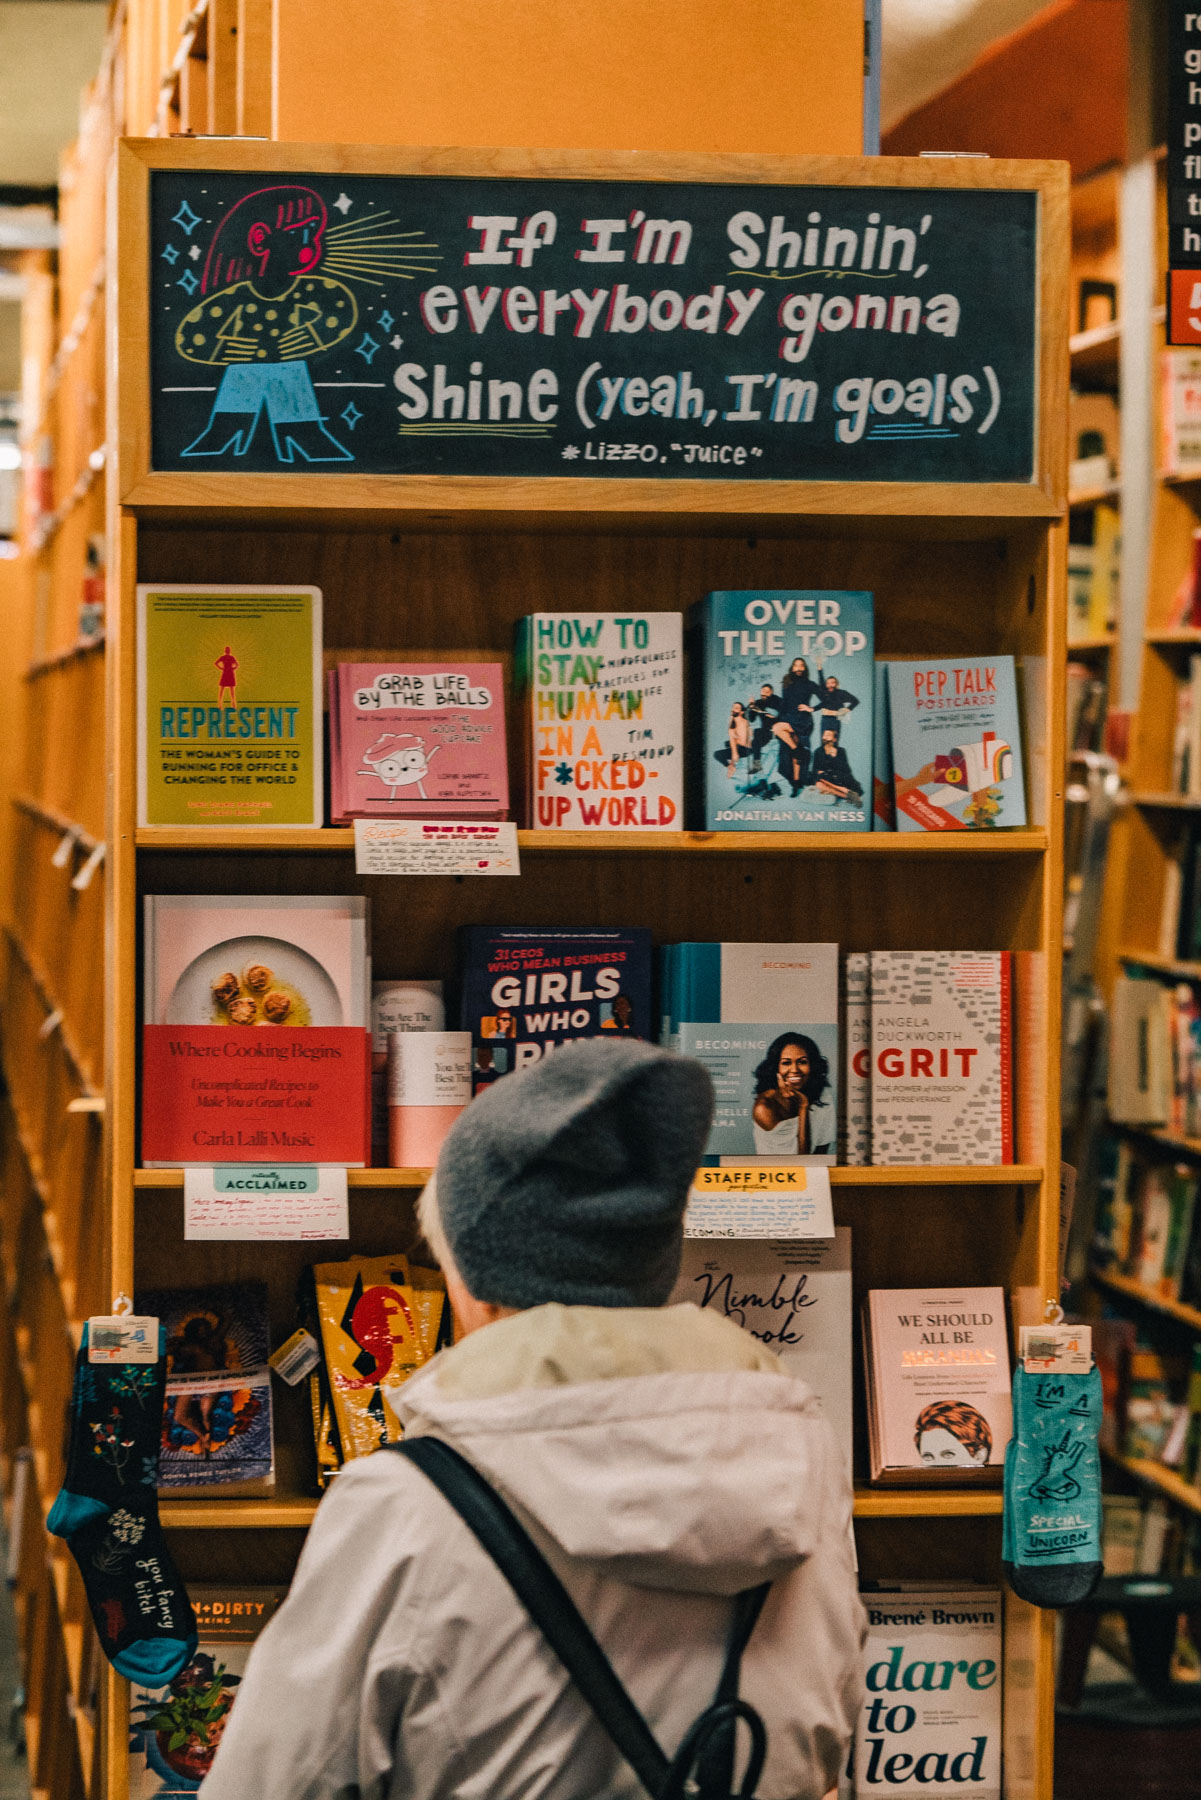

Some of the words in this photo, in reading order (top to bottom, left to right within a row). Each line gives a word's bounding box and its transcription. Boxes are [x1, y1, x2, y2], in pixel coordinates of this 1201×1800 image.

[464, 211, 557, 267] If
[575, 209, 692, 265] I'm
[420, 284, 764, 338] everybody
[779, 288, 960, 362] gonna
[393, 362, 558, 423] Shine
[576, 362, 717, 429] (yeah,
[722, 371, 819, 422] I'm
[834, 366, 1000, 443] goals)
[745, 600, 841, 625] OVER
[538, 619, 603, 649] HOW
[614, 619, 649, 649] TO
[718, 630, 786, 656] THE
[796, 630, 868, 657] TOP
[608, 650, 676, 668] MINDFULNESS
[538, 654, 603, 686] STAY
[378, 676, 424, 690] GRAB
[434, 676, 467, 690] LIFE
[589, 671, 646, 690] PRACTICES
[914, 671, 948, 697] PEP
[953, 668, 997, 695] TALK
[357, 692, 380, 708] BY
[391, 691, 425, 706] THE
[436, 690, 489, 706] BALLS
[538, 691, 643, 720] HUMAN
[916, 695, 996, 709] POSTCARDS
[160, 707, 299, 738] REPRESENT
[538, 726, 573, 756] IN
[581, 726, 603, 756] A
[627, 729, 653, 743] TIM
[160, 750, 182, 759] THE
[186, 750, 242, 759] WOMAN'S
[246, 750, 281, 759] GUIDE
[286, 750, 300, 759] TO
[612, 745, 674, 764] DESMOND
[162, 763, 217, 772] RUNNING
[220, 763, 243, 772] FOR
[247, 763, 287, 772] OFFICE
[164, 776, 227, 785] CHANGING
[231, 776, 252, 785] THE
[256, 776, 296, 785] WORLD
[538, 796, 571, 826] UP
[577, 795, 676, 826] WORLD
[714, 810, 792, 822] JONATHAN
[796, 811, 825, 822] VAN
[828, 811, 866, 822] NESS
[488, 961, 520, 972] WHO
[522, 957, 561, 970] MEAN
[563, 952, 627, 966] BUSINESS
[495, 949, 509, 960] 31
[511, 948, 544, 959] CEOS
[491, 967, 621, 1008] GIRLS
[525, 1009, 590, 1033] WHO
[878, 1017, 929, 1027] ANGELA
[696, 1040, 767, 1049] BECOMING
[877, 1032, 962, 1041] DUCKWORTH
[169, 1041, 220, 1057] Where
[223, 1042, 288, 1061] Cooking
[291, 1043, 342, 1061] Begins
[877, 1048, 978, 1078] GRIT
[270, 1079, 306, 1093] Recipes
[196, 1096, 225, 1108] Make
[255, 1096, 284, 1108] Great
[286, 1096, 313, 1108] Cook
[193, 1131, 234, 1146] Carla
[237, 1131, 268, 1146] Lalli
[271, 1132, 315, 1146] Music
[226, 1180, 308, 1190] ACCLAIMED
[704, 1172, 752, 1183] STAFF
[759, 1172, 797, 1183] PICK
[684, 1228, 735, 1237] ECOMING
[694, 1273, 818, 1316] Nimble
[897, 1314, 923, 1327] WE
[926, 1313, 993, 1327] SHOULD
[920, 1332, 950, 1344] ALL
[953, 1331, 974, 1344] BE
[902, 1349, 997, 1364] MIRANDAS
[1035, 1383, 1064, 1398] I'M
[1075, 1394, 1088, 1408] A
[1030, 1515, 1085, 1527] SPECIAL
[1030, 1532, 1088, 1548] UNICORN
[134, 1580, 156, 1615] bitch
[135, 1557, 163, 1583] you
[157, 1589, 174, 1629] fancy
[868, 1610, 926, 1626] Brené
[931, 1609, 994, 1624] Brown
[866, 1646, 997, 1692] dare
[865, 1698, 917, 1734] to
[865, 1736, 988, 1784] lead
